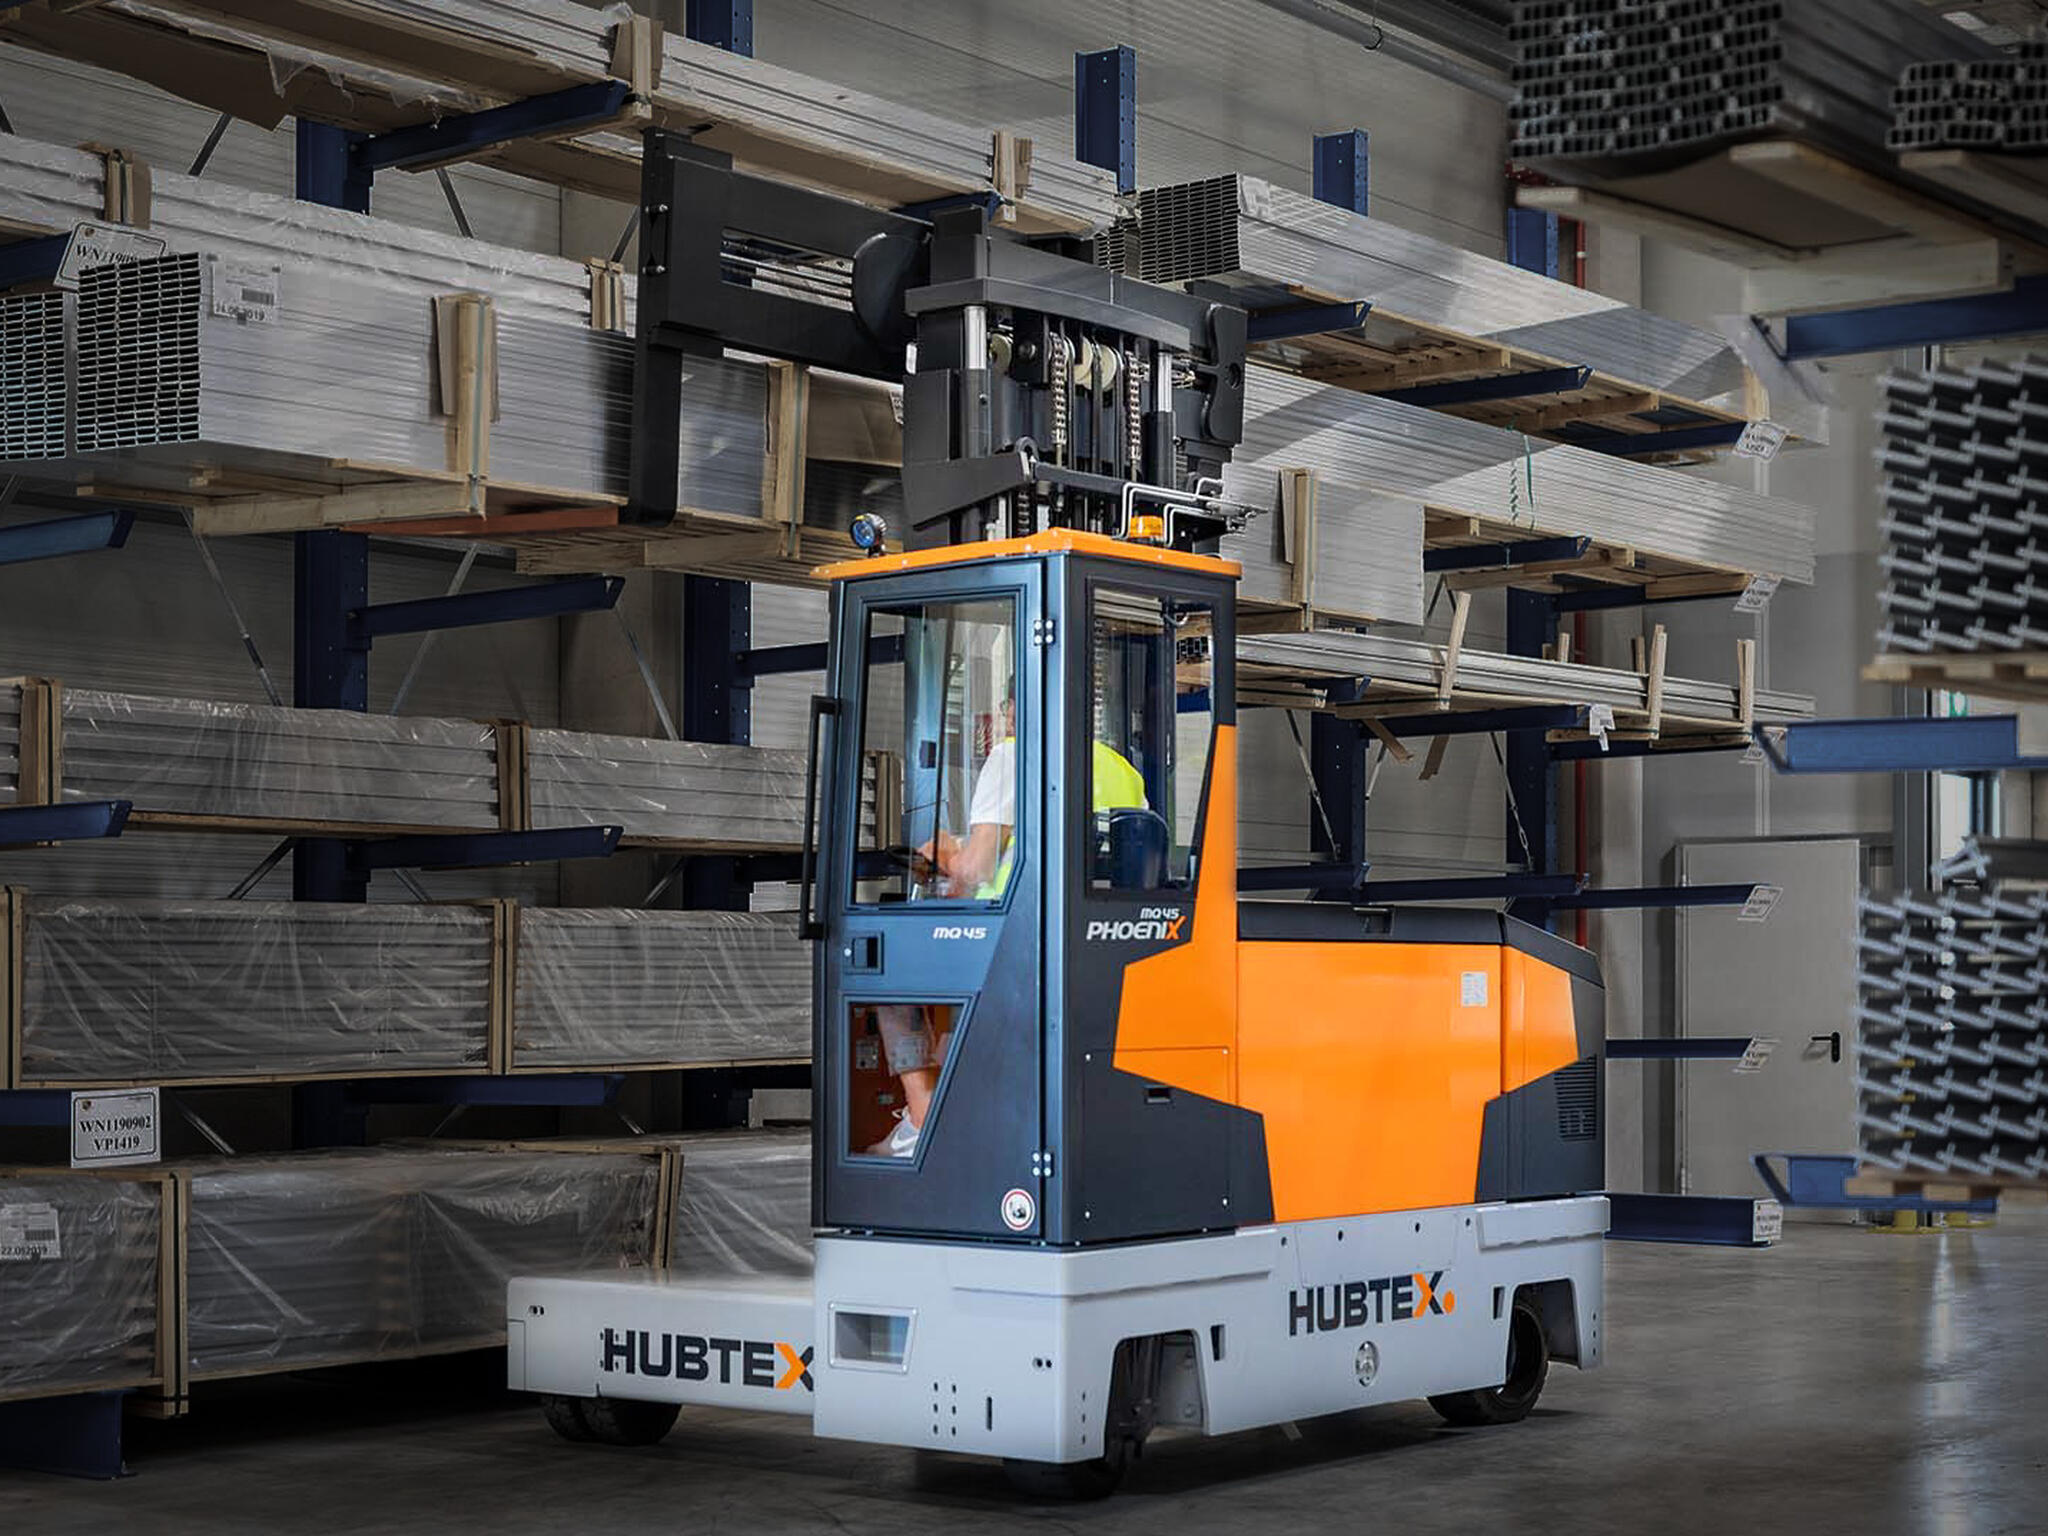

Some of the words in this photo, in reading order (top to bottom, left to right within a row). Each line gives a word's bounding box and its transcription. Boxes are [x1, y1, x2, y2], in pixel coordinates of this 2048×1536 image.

[1086, 916, 1187, 940] PHOENIX
[80, 1115, 151, 1133] WN1190902
[1289, 1270, 1444, 1337] HUBTEX
[603, 1327, 815, 1392] HUBTEX
